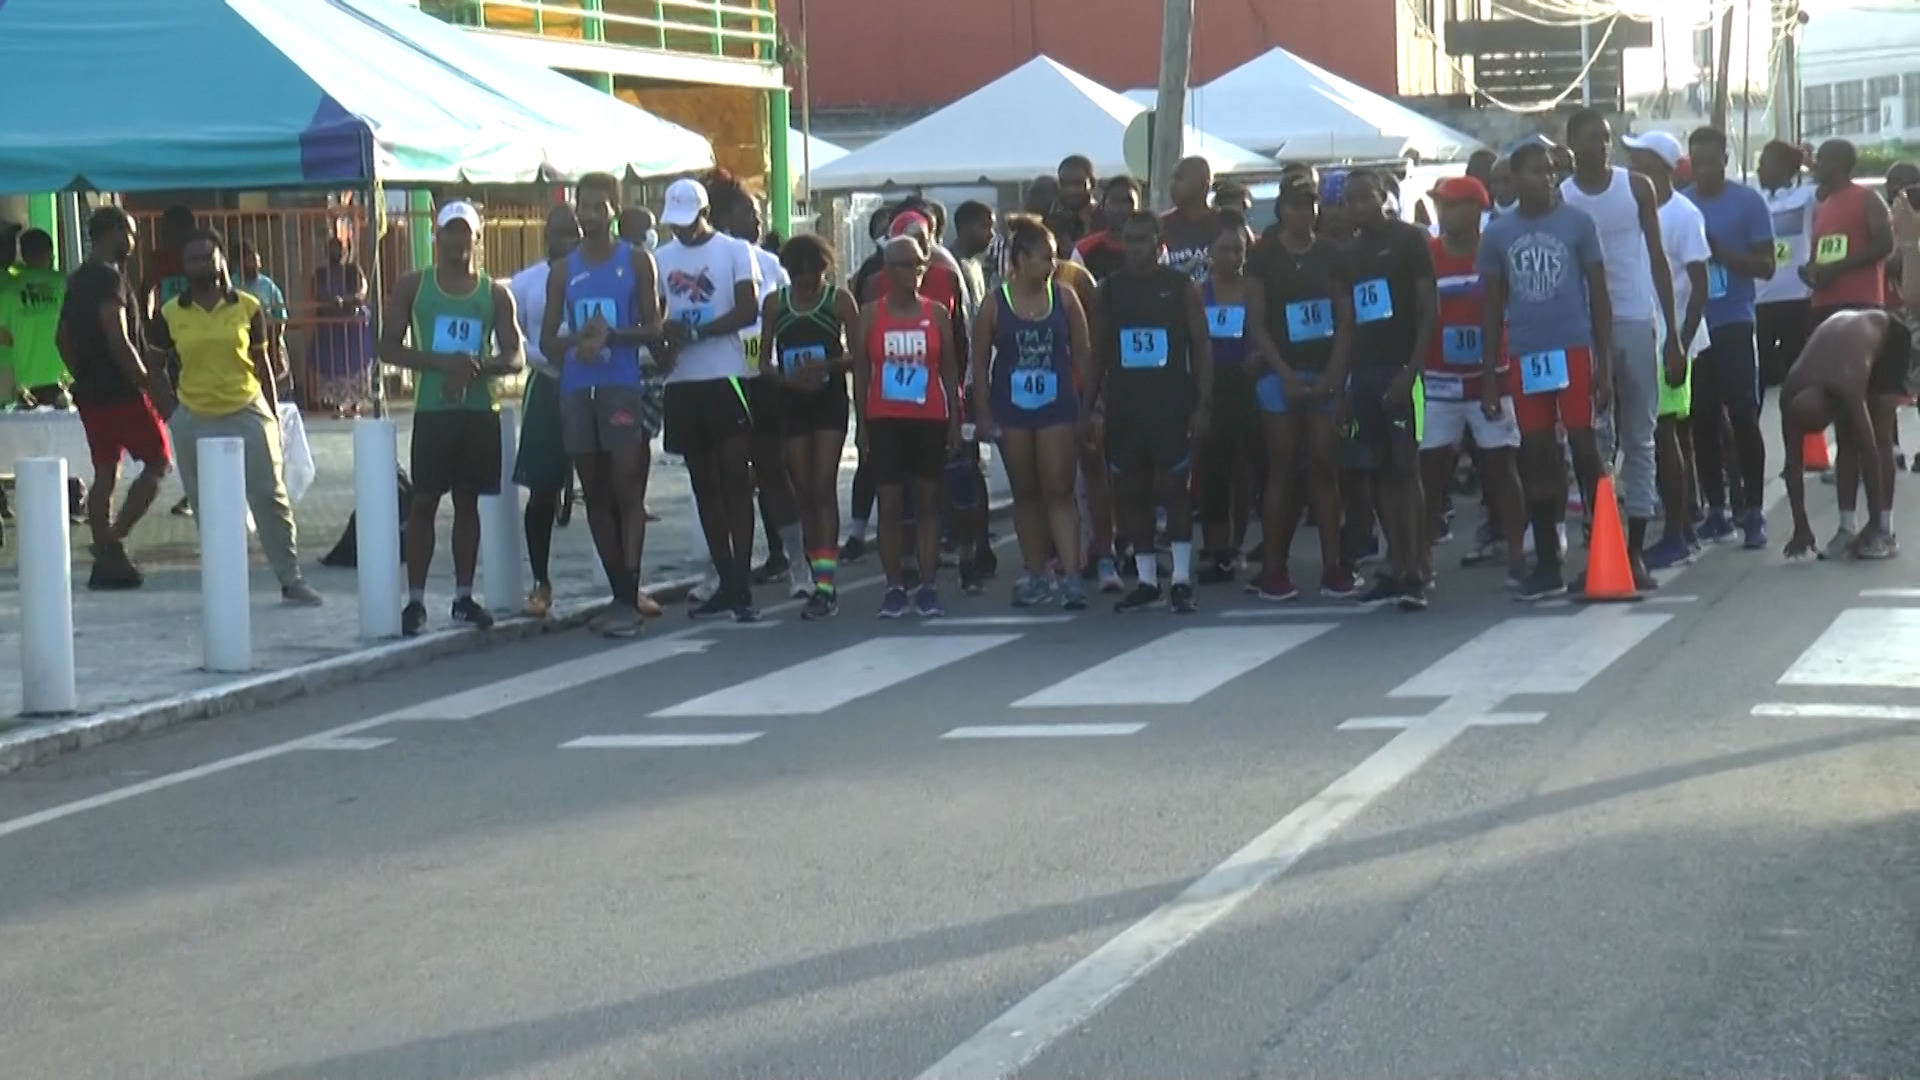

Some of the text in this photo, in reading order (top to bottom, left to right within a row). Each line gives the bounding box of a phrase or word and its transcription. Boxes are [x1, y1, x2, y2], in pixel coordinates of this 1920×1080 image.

[1360, 284, 1378, 308] 26
[1216, 308, 1227, 327] 6
[447, 320, 470, 341] 49
[1132, 332, 1154, 353] 53
[1530, 354, 1551, 377] 51
[895, 367, 917, 387] 47
[1023, 375, 1045, 395] 46
